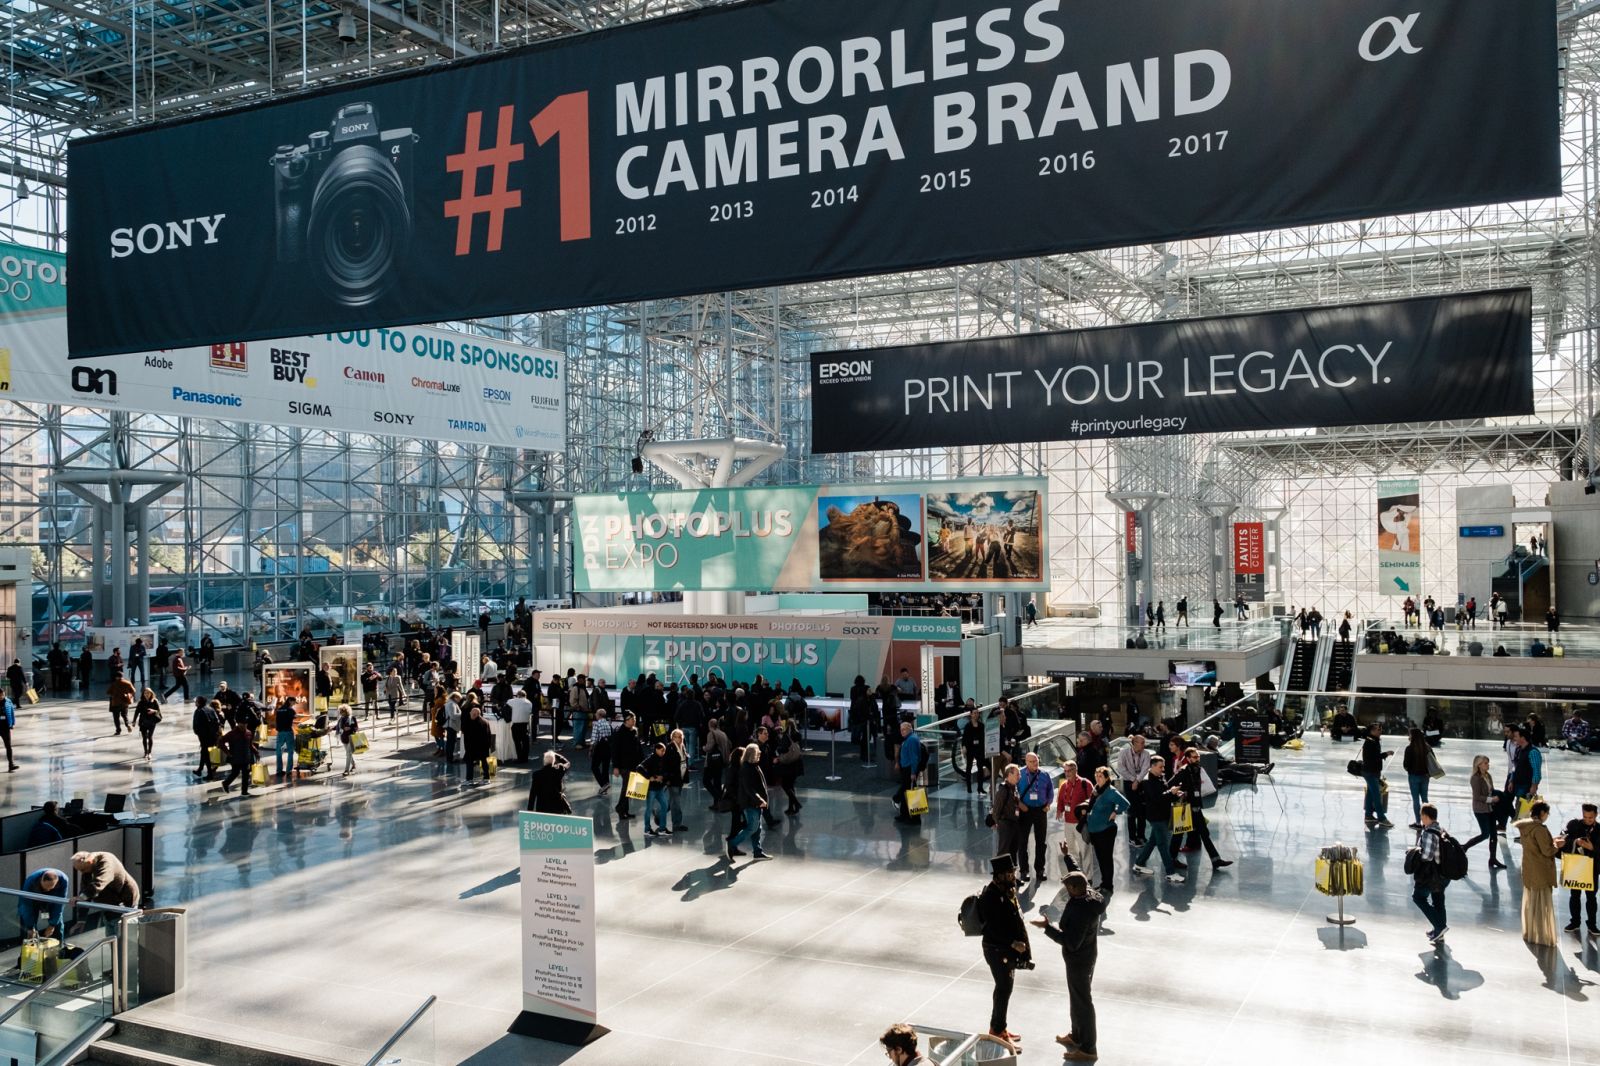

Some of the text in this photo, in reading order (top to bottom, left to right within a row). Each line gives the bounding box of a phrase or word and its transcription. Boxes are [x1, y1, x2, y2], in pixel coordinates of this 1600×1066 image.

[616, 0, 1065, 136] MIRRORLESS
[341, 123, 370, 134] SONY
[615, 49, 1232, 200] CAMERA BRAND
[1168, 130, 1229, 158] 2017
[1038, 151, 1096, 176] 2016
[444, 90, 592, 256] #1
[919, 169, 971, 193] 2015
[810, 185, 859, 209] 2014
[709, 201, 754, 222] 2013
[615, 214, 657, 235] 2012
[110, 213, 226, 259] SONY
[270, 347, 310, 368] BEST
[377, 327, 407, 353] TO
[412, 335, 455, 362] OUR
[460, 343, 559, 380] SPONSORS!
[144, 355, 174, 370] Adobe
[819, 360, 872, 378] EPSON
[72, 365, 117, 396] on
[273, 364, 307, 383] BUY
[343, 366, 386, 383] Canon
[904, 340, 1393, 415] PRINT YOUR LEGACY.
[411, 376, 461, 393] ChromaLuxe
[172, 386, 242, 408] Panasonic
[482, 387, 511, 401] EPSON
[530, 395, 560, 407] FUJIFILM
[288, 400, 332, 417] SIGMA
[373, 411, 415, 425] SONY
[447, 418, 487, 433] TAMRON
[1069, 413, 1188, 436] #printyourlegacy
[582, 508, 794, 569] PDN PHOTOPLUS
[604, 542, 679, 570] EXPO
[1239, 528, 1260, 567] JAVITS CENTER
[1242, 573, 1257, 584] 1E
[542, 621, 573, 630] SONY
[647, 621, 662, 629] NOT
[663, 621, 708, 629] REGISTERED?
[728, 622, 738, 630] UP
[740, 622, 758, 630] HERE
[771, 622, 831, 632] PHOTOPLUS
[842, 626, 880, 635] SONY
[912, 625, 935, 633] EXPO
[664, 640, 819, 665] PHOTOPLUS
[530, 821, 588, 837] PHOTOPLUS
[530, 830, 554, 842] EXPO
[1174, 825, 1192, 833] Nikon
[545, 857, 561, 865] LEVEL
[1563, 879, 1592, 889] Nikon
[546, 892, 563, 900] LEVEL
[547, 928, 563, 936] LEVEL
[548, 964, 564, 972] LEVEL
